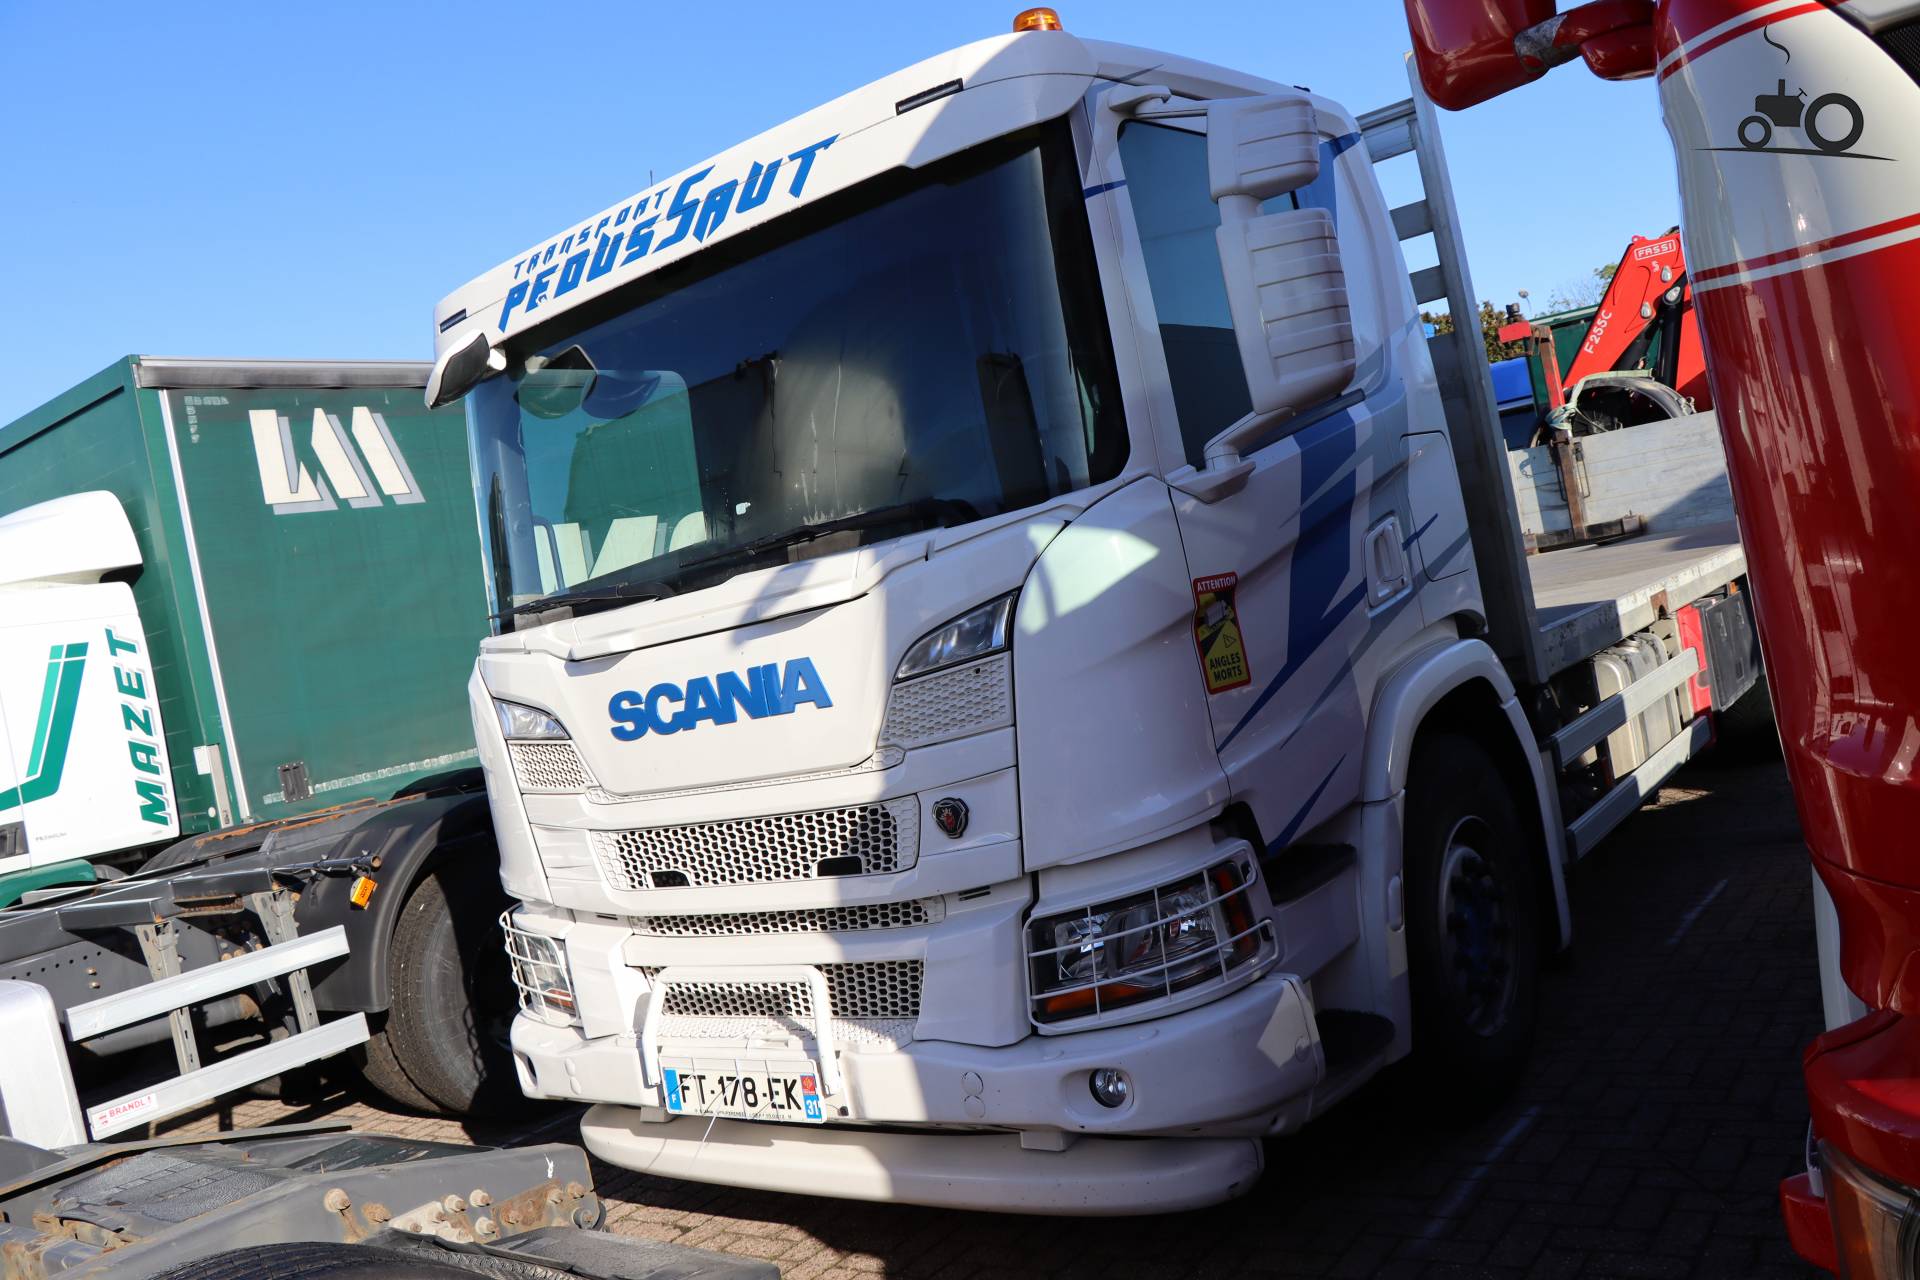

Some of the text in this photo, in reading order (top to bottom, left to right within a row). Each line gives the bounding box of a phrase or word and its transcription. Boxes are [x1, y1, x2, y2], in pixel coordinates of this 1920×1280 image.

[514, 187, 670, 279] TRANSPORT
[1638, 242, 1673, 257] FASSI
[1197, 575, 1236, 592] ATTENTION
[1210, 652, 1240, 670] ANGLES
[1213, 665, 1242, 682] MORTS
[608, 656, 833, 742] SCANIA
[105, 626, 171, 826] MAZET
[678, 1073, 802, 1111] FT-178-EK
[807, 1099, 819, 1116] 31
